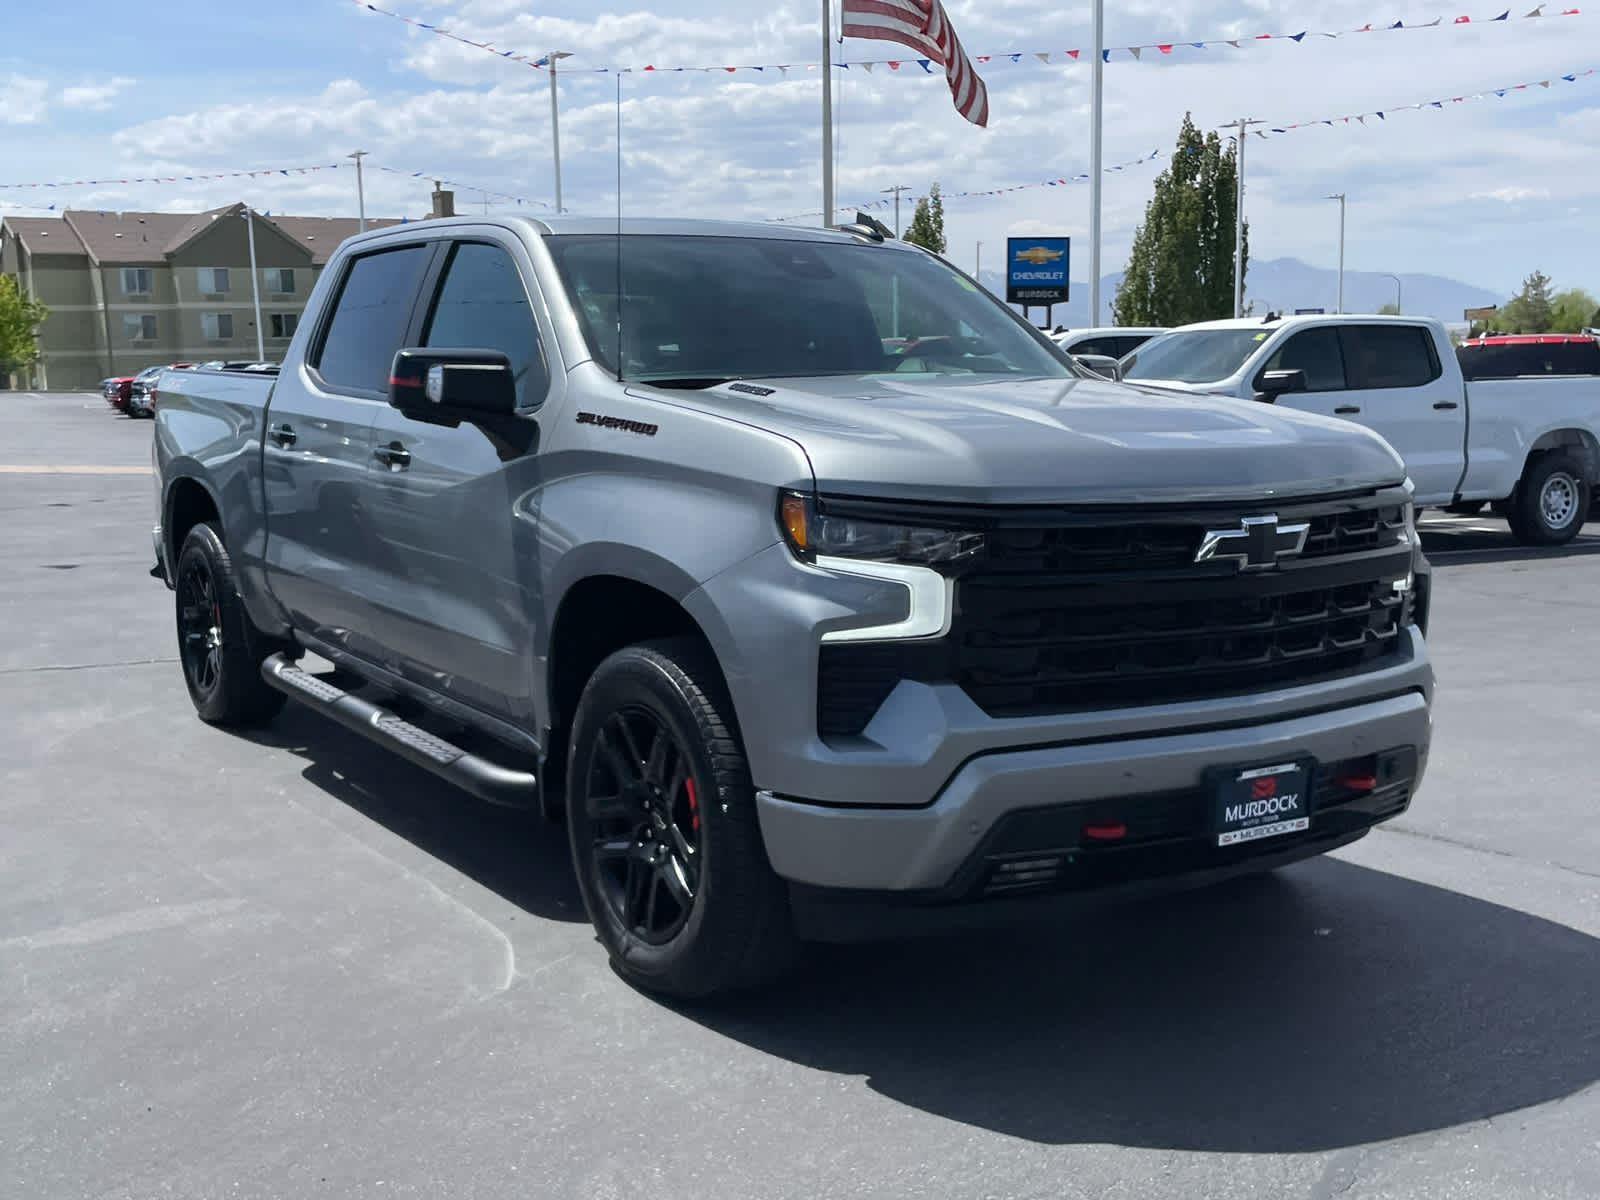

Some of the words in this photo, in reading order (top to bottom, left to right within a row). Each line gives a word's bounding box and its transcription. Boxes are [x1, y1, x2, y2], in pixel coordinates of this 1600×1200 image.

[1012, 271, 1064, 281] CHEVROLET
[1016, 290, 1060, 298] MURDOCK
[576, 411, 659, 436] SILVERADO
[1225, 794, 1299, 823] MURDOCK
[1240, 823, 1287, 840] MURDOCK
